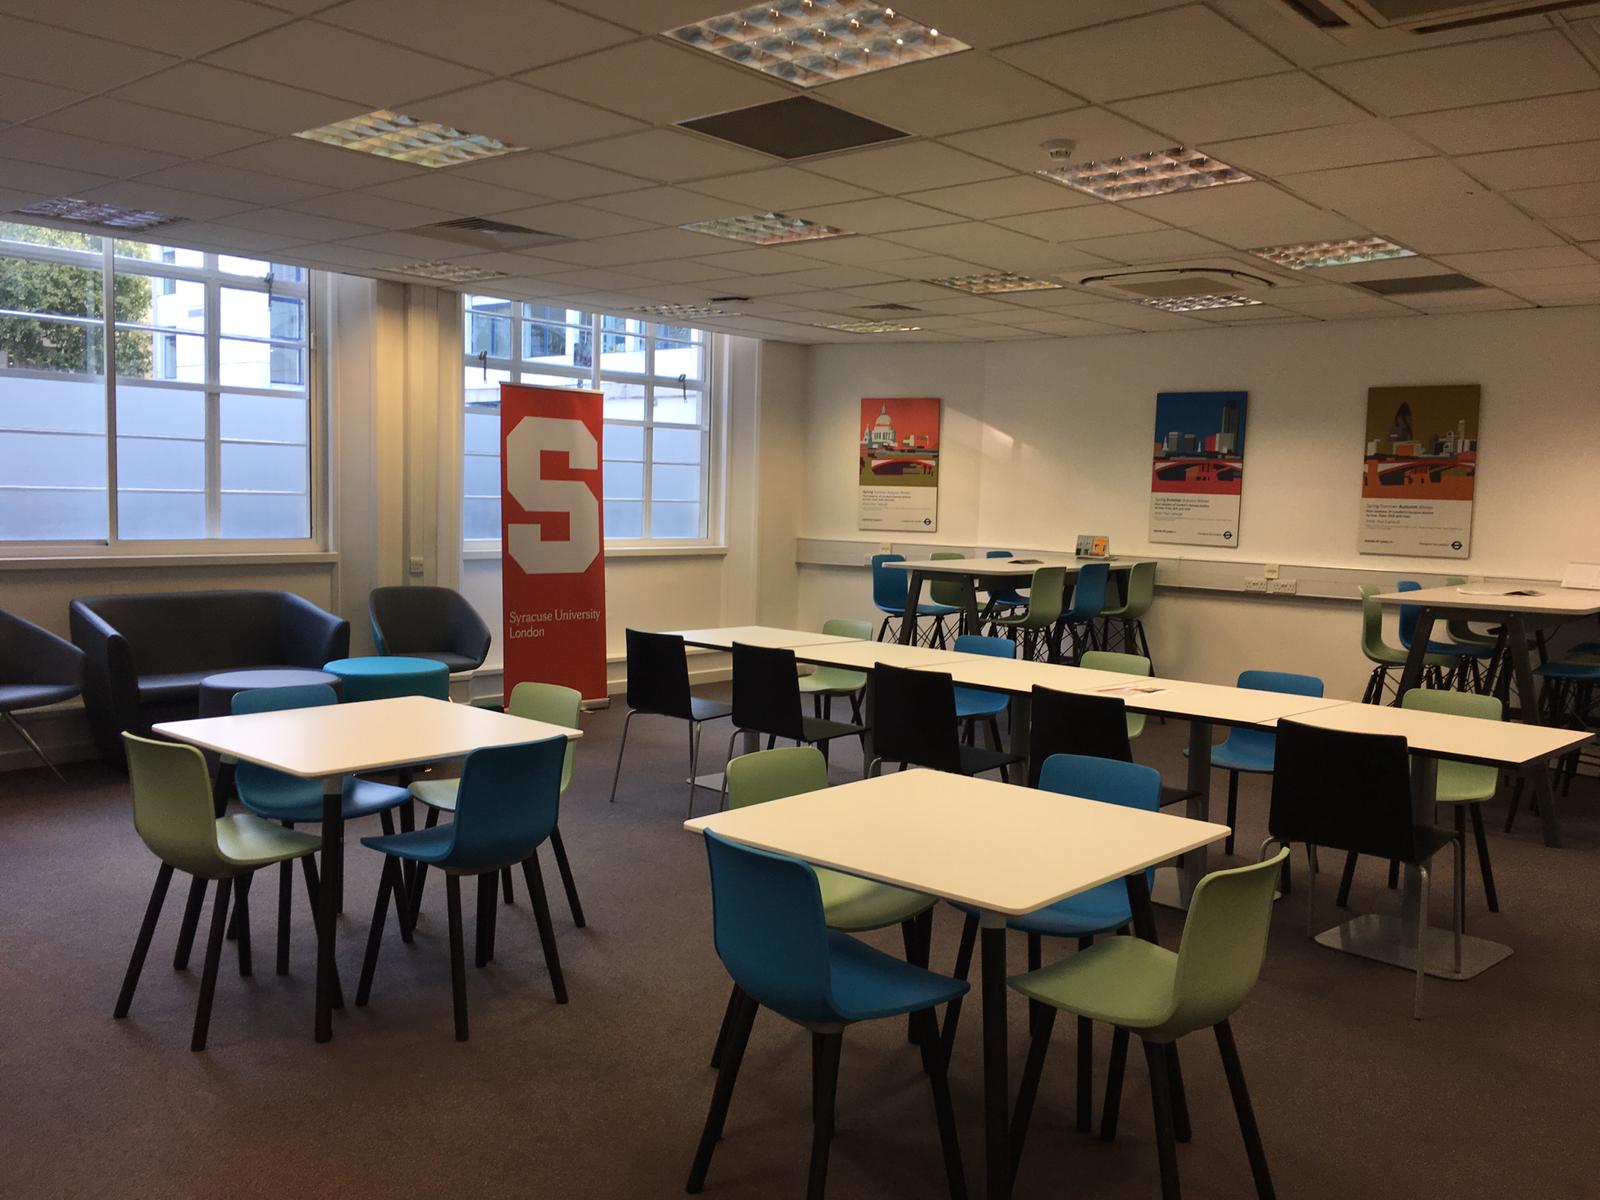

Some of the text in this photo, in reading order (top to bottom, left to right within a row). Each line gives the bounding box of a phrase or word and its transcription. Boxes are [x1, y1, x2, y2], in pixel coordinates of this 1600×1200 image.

[506, 416, 600, 575] S
[509, 608, 601, 626] Syracuse University
[509, 625, 545, 639] London
